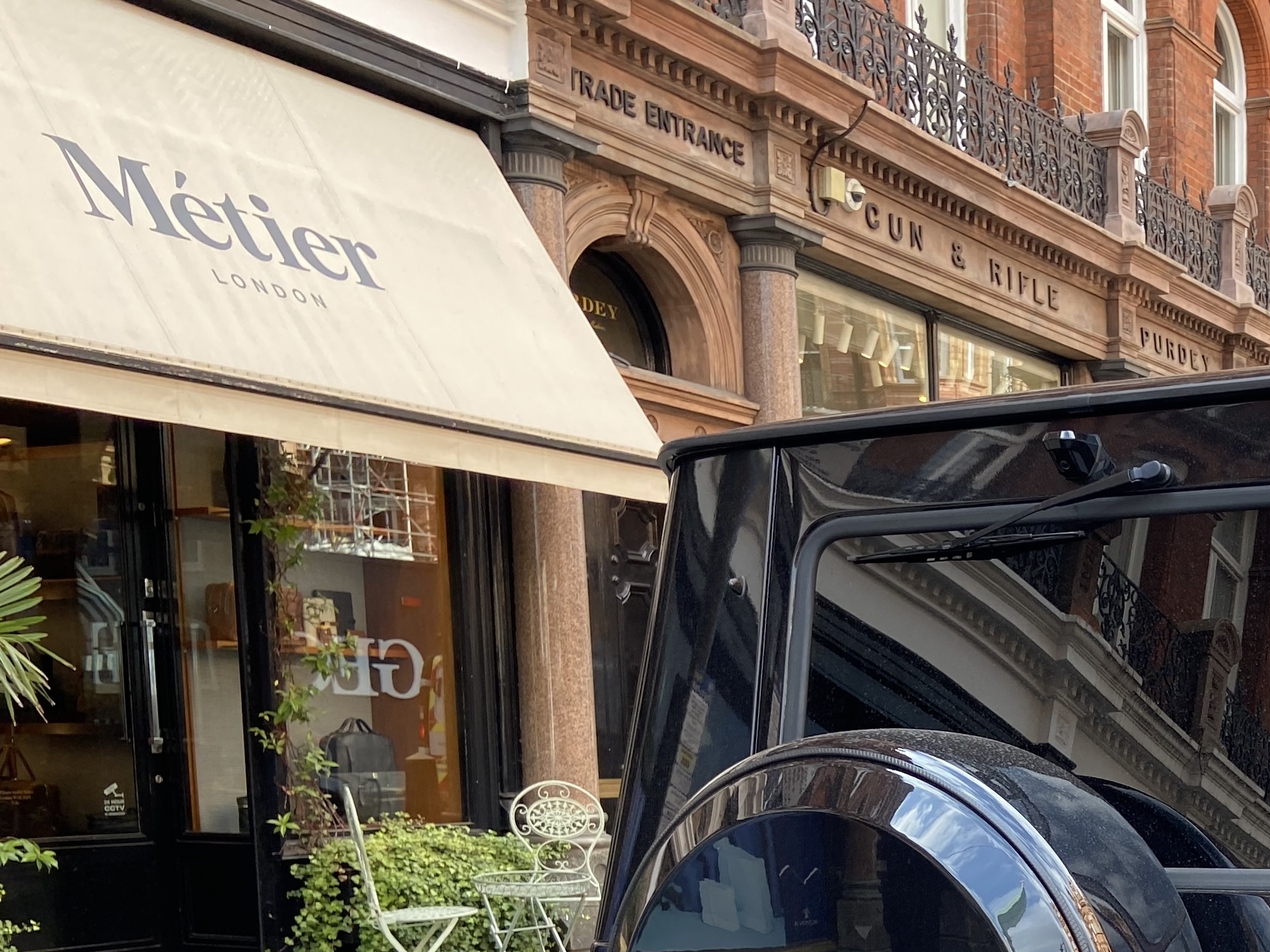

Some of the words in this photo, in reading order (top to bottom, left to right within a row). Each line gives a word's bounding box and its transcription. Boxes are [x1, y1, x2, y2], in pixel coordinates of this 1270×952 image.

[571, 66, 637, 118] TRADE
[645, 100, 746, 166] ENTRANCE
[41, 132, 386, 291] Métier
[864, 202, 923, 251] GUN
[952, 241, 967, 270] &
[989, 258, 1060, 311] RIFLE
[211, 268, 328, 319] LONDON
[1140, 326, 1210, 372] PURDEY
